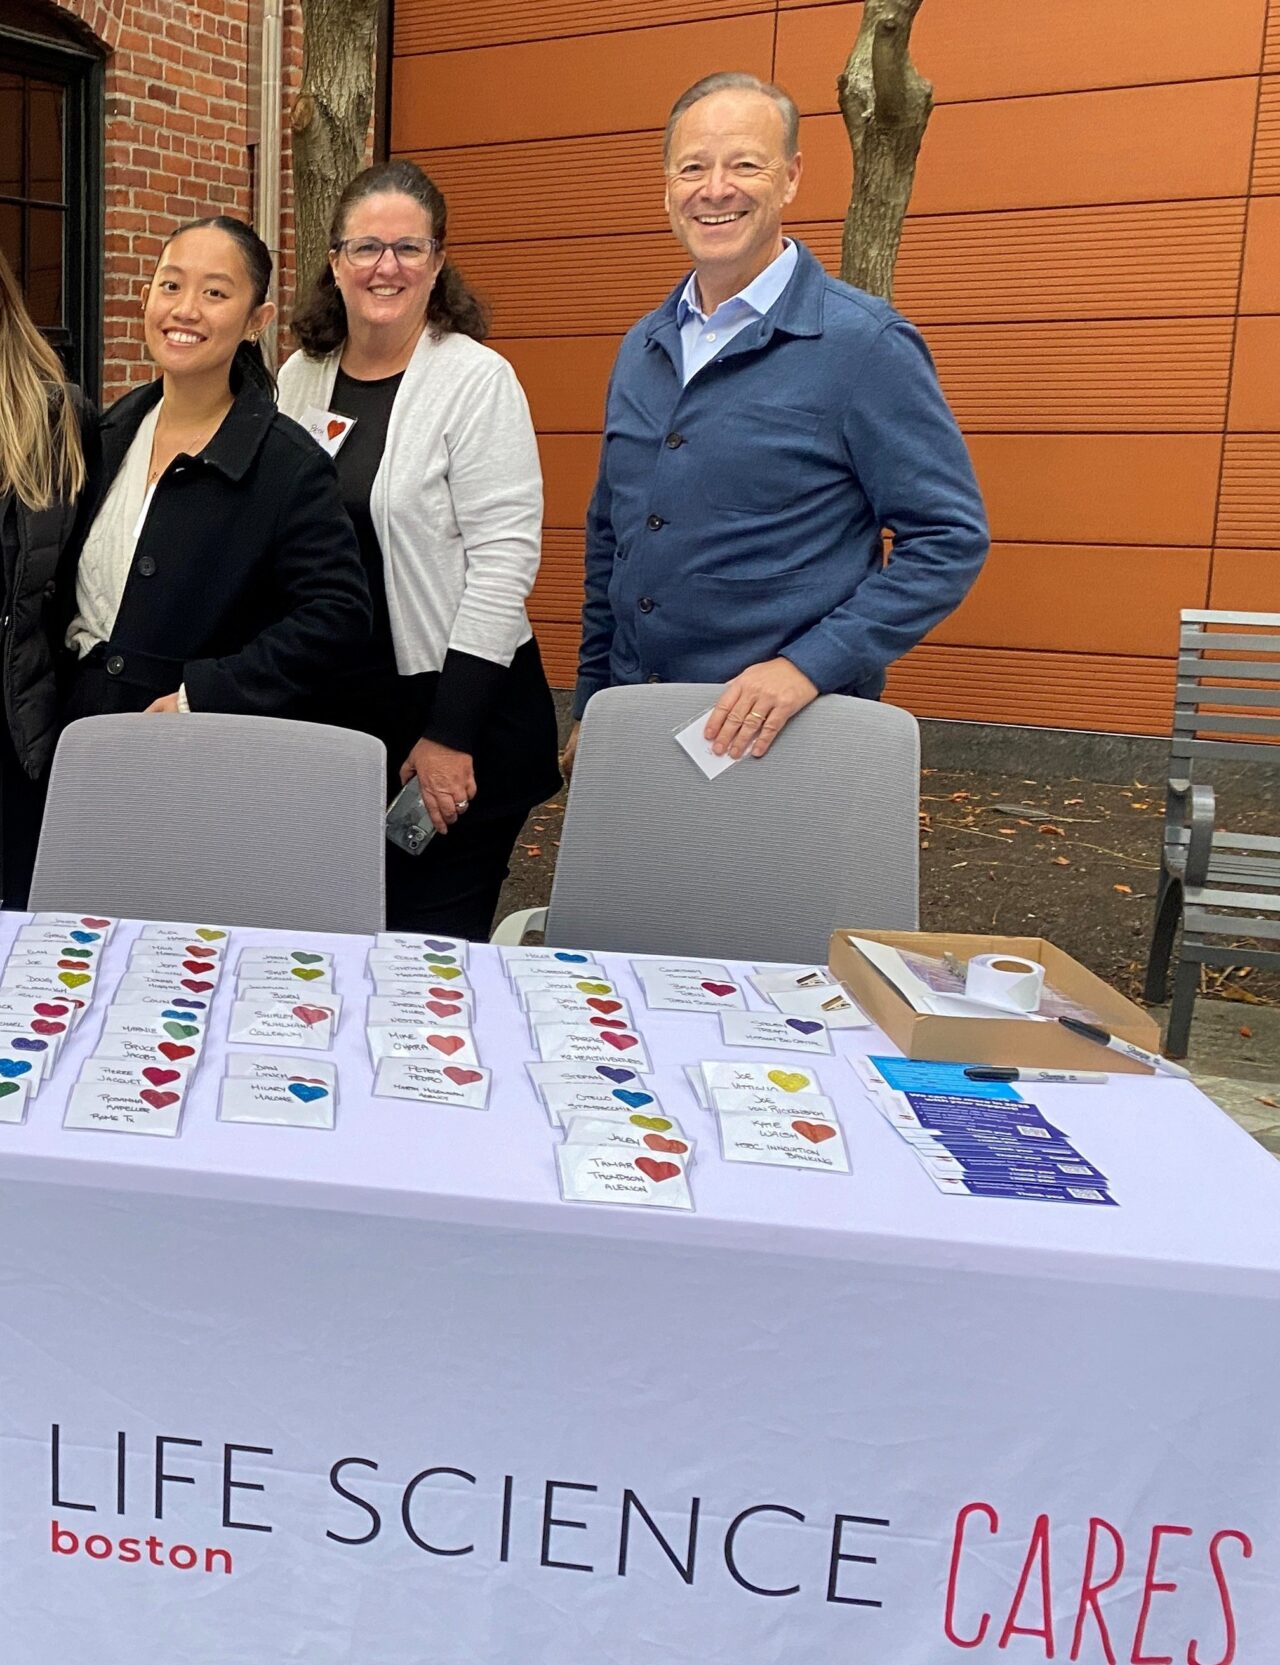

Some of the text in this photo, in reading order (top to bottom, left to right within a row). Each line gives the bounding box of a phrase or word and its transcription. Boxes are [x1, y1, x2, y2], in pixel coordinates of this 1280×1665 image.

[26, 974, 53, 984] DOUG
[254, 1010, 294, 1019] SHIRLEY
[388, 1032, 417, 1040] MIKE
[121, 1040, 157, 1052] BRUCE
[122, 1051, 157, 1061] JACOBS
[402, 1064, 443, 1076] PETER
[733, 1070, 754, 1080] JOE
[403, 1072, 443, 1084] PEDRO
[753, 1094, 775, 1104] JOE
[90, 1113, 119, 1121] ROME
[759, 1130, 800, 1141] WALSH
[588, 1157, 635, 1170] TAMAR
[587, 1171, 645, 1183] THOMPSON
[604, 1183, 649, 1193] ALEXION
[50, 1519, 233, 1574] boston
[51, 1423, 1253, 1665] LIFE SCIENCE CARES
